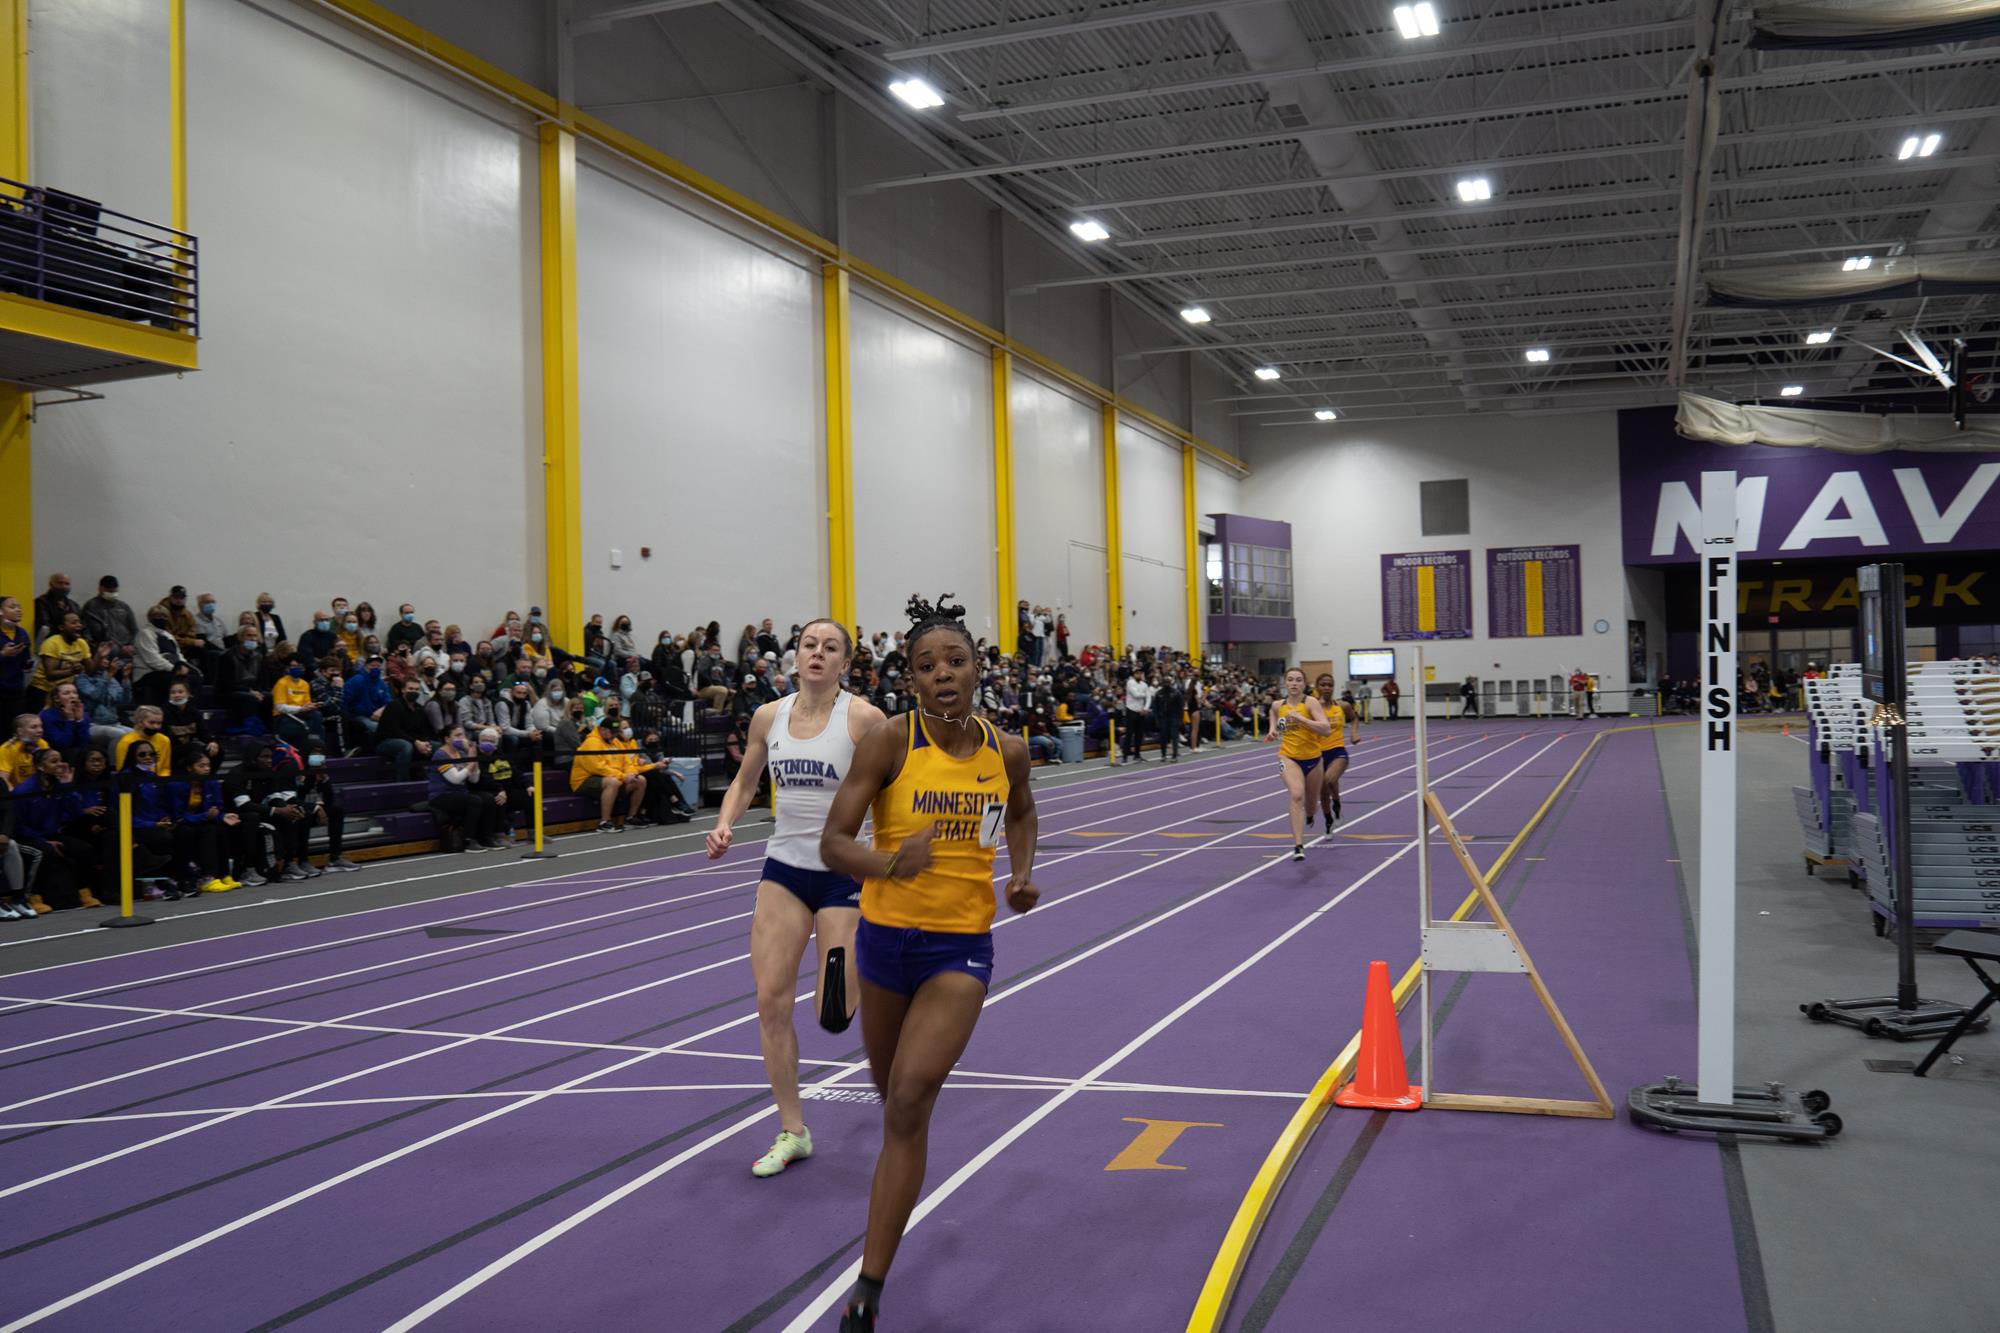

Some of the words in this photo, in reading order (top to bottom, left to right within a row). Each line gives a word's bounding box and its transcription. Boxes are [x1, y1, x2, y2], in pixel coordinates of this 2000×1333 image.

[1393, 557, 1422, 566] INDOOR
[1424, 555, 1457, 565] RECORDS
[1496, 552, 1533, 562] OUTDOOR
[1535, 550, 1570, 559] RECORDS
[1707, 557, 1731, 751] FINISH
[774, 766, 785, 787] 8
[988, 805, 1004, 839] 7
